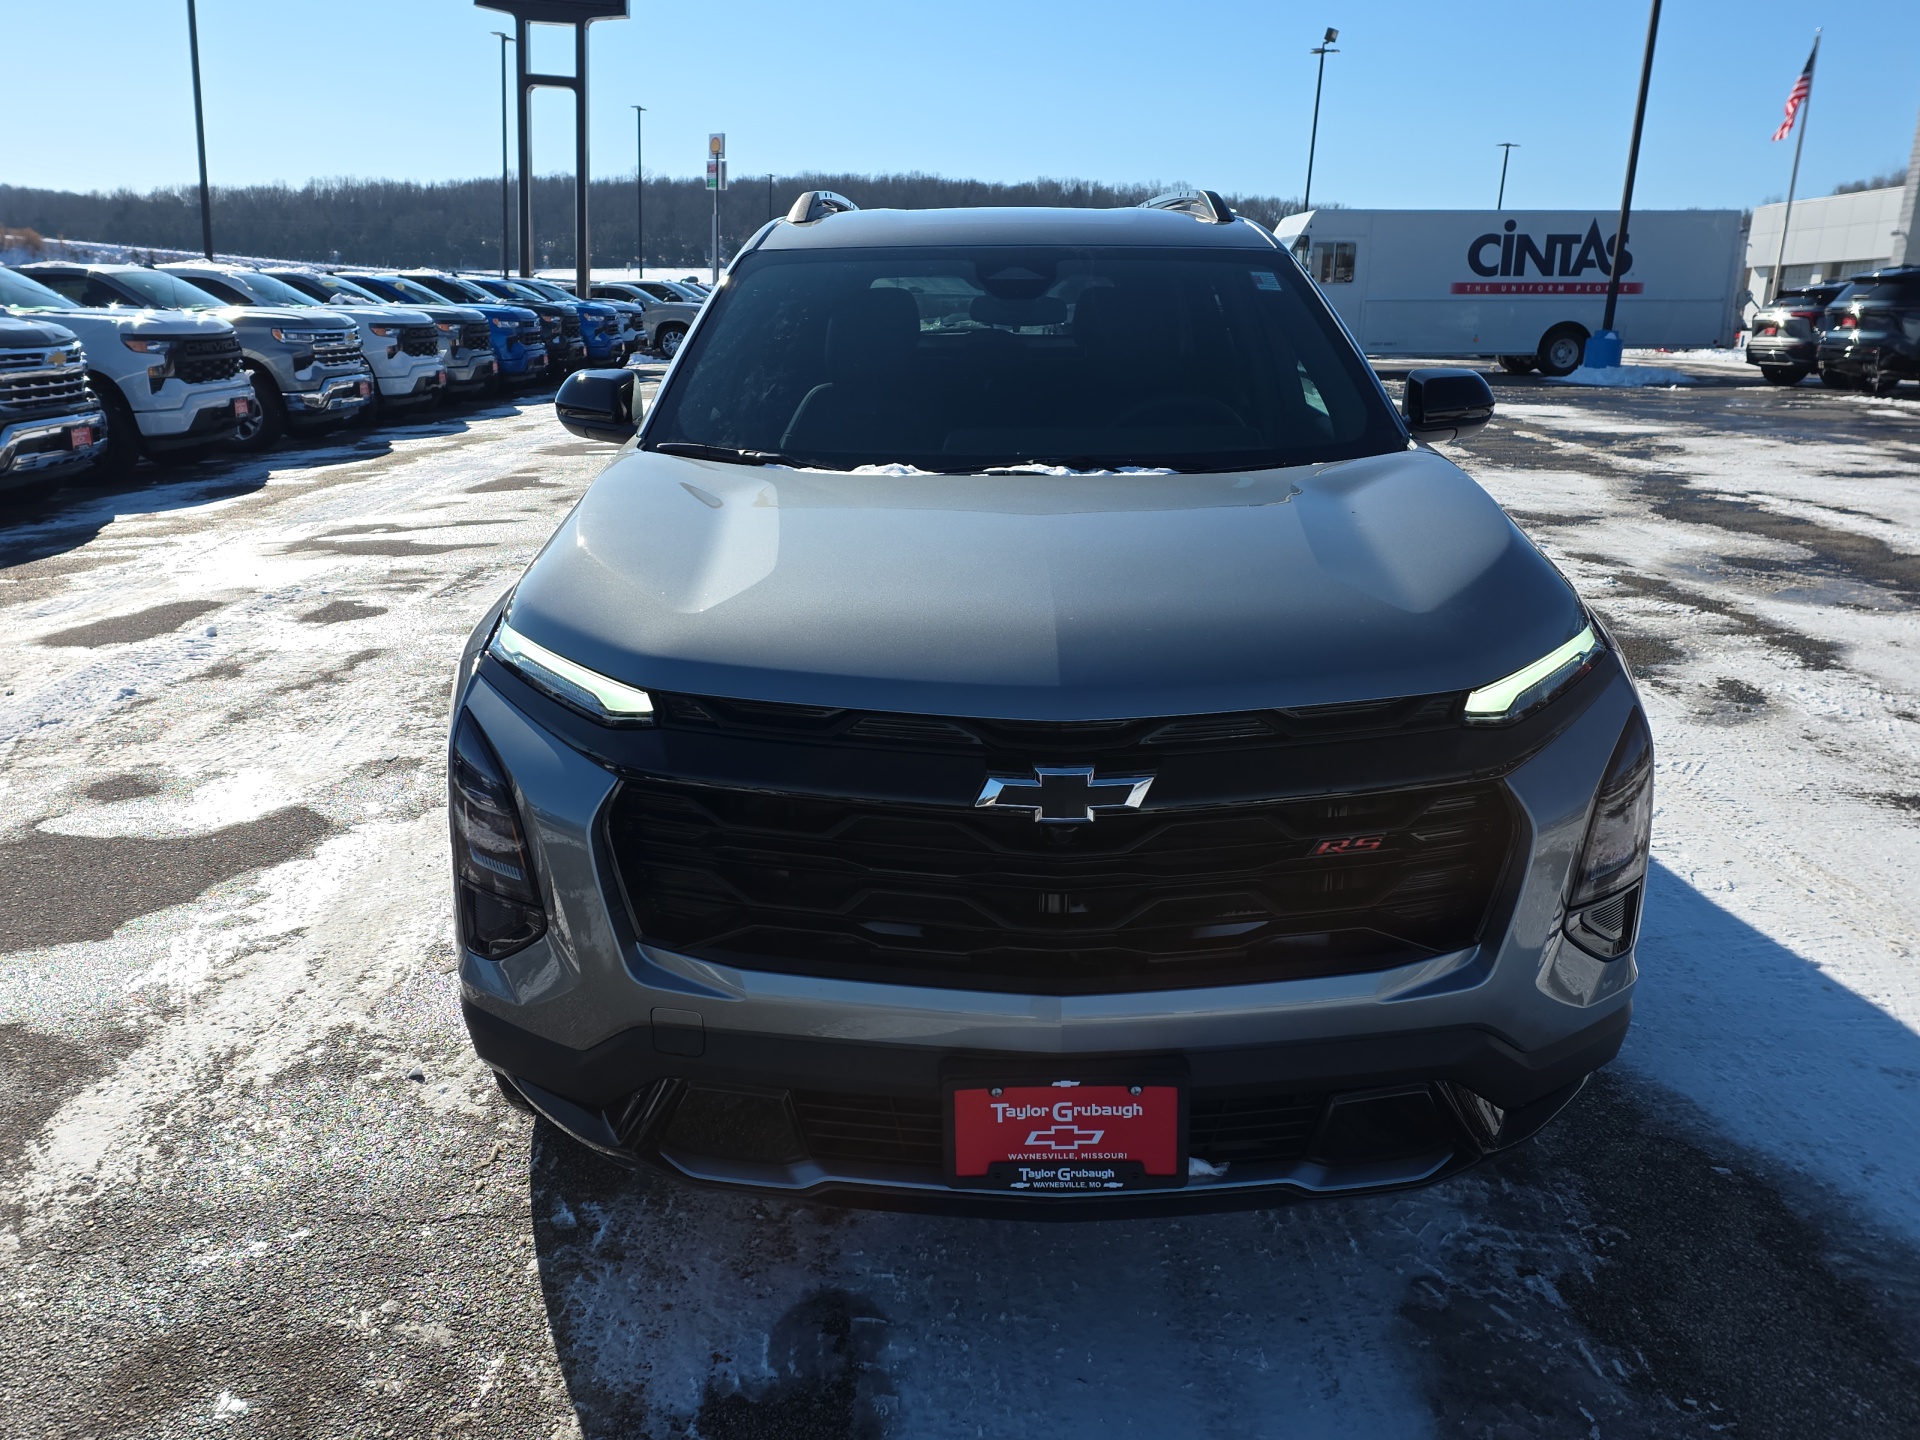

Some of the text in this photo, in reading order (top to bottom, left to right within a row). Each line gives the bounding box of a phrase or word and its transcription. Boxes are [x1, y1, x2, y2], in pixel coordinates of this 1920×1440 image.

[1466, 284, 1629, 292] THE UNIFORM PEOE
[1313, 836, 1385, 855] RS
[990, 1102, 1143, 1123] Taylor Grubaugh
[1081, 1152, 1128, 1160] MISSOURI
[1018, 1167, 1115, 1181] Taylor Grubaugh
